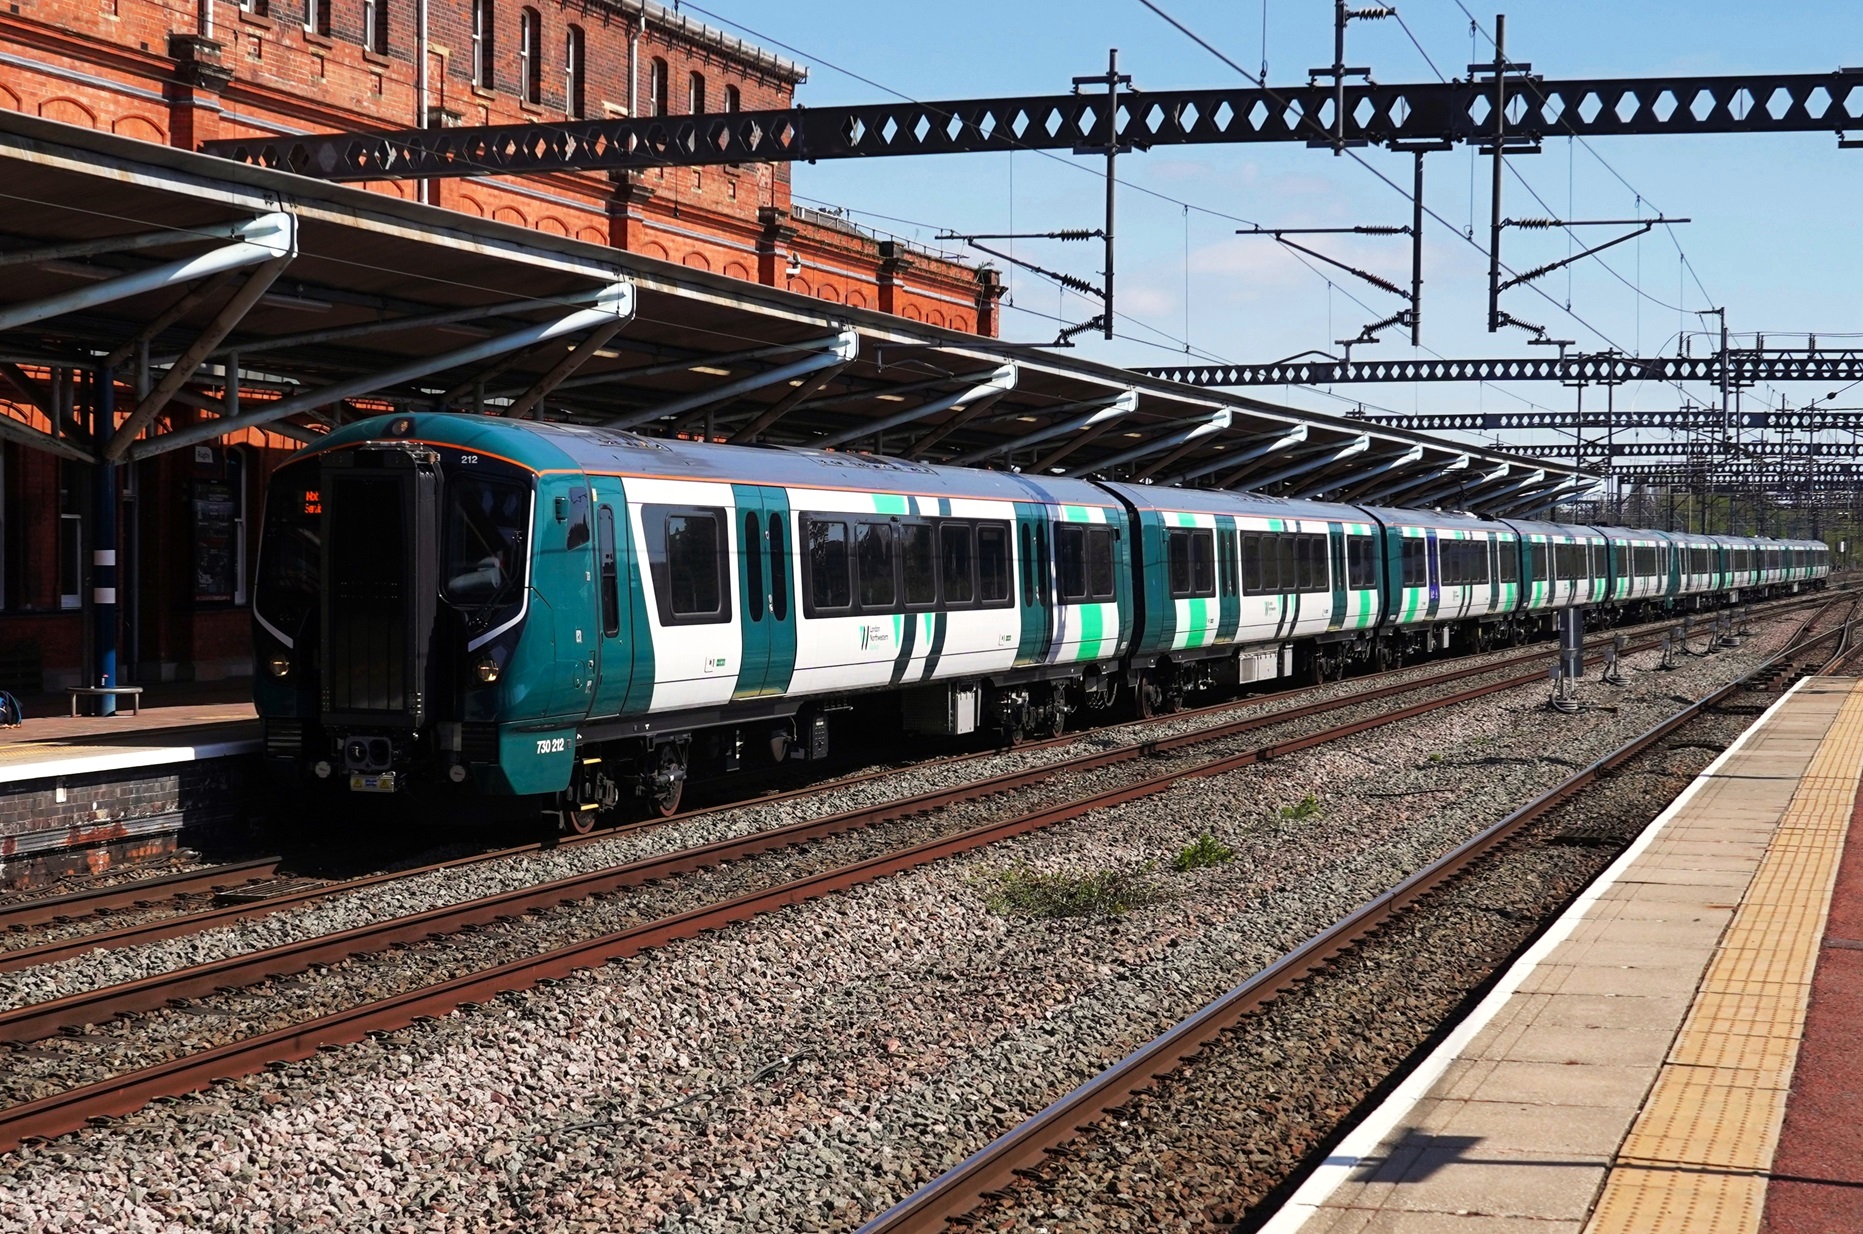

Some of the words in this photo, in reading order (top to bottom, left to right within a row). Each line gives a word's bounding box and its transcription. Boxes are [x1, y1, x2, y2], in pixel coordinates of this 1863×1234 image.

[461, 455, 479, 464] 212
[536, 739, 551, 754] 730
[551, 737, 565, 752] 212
